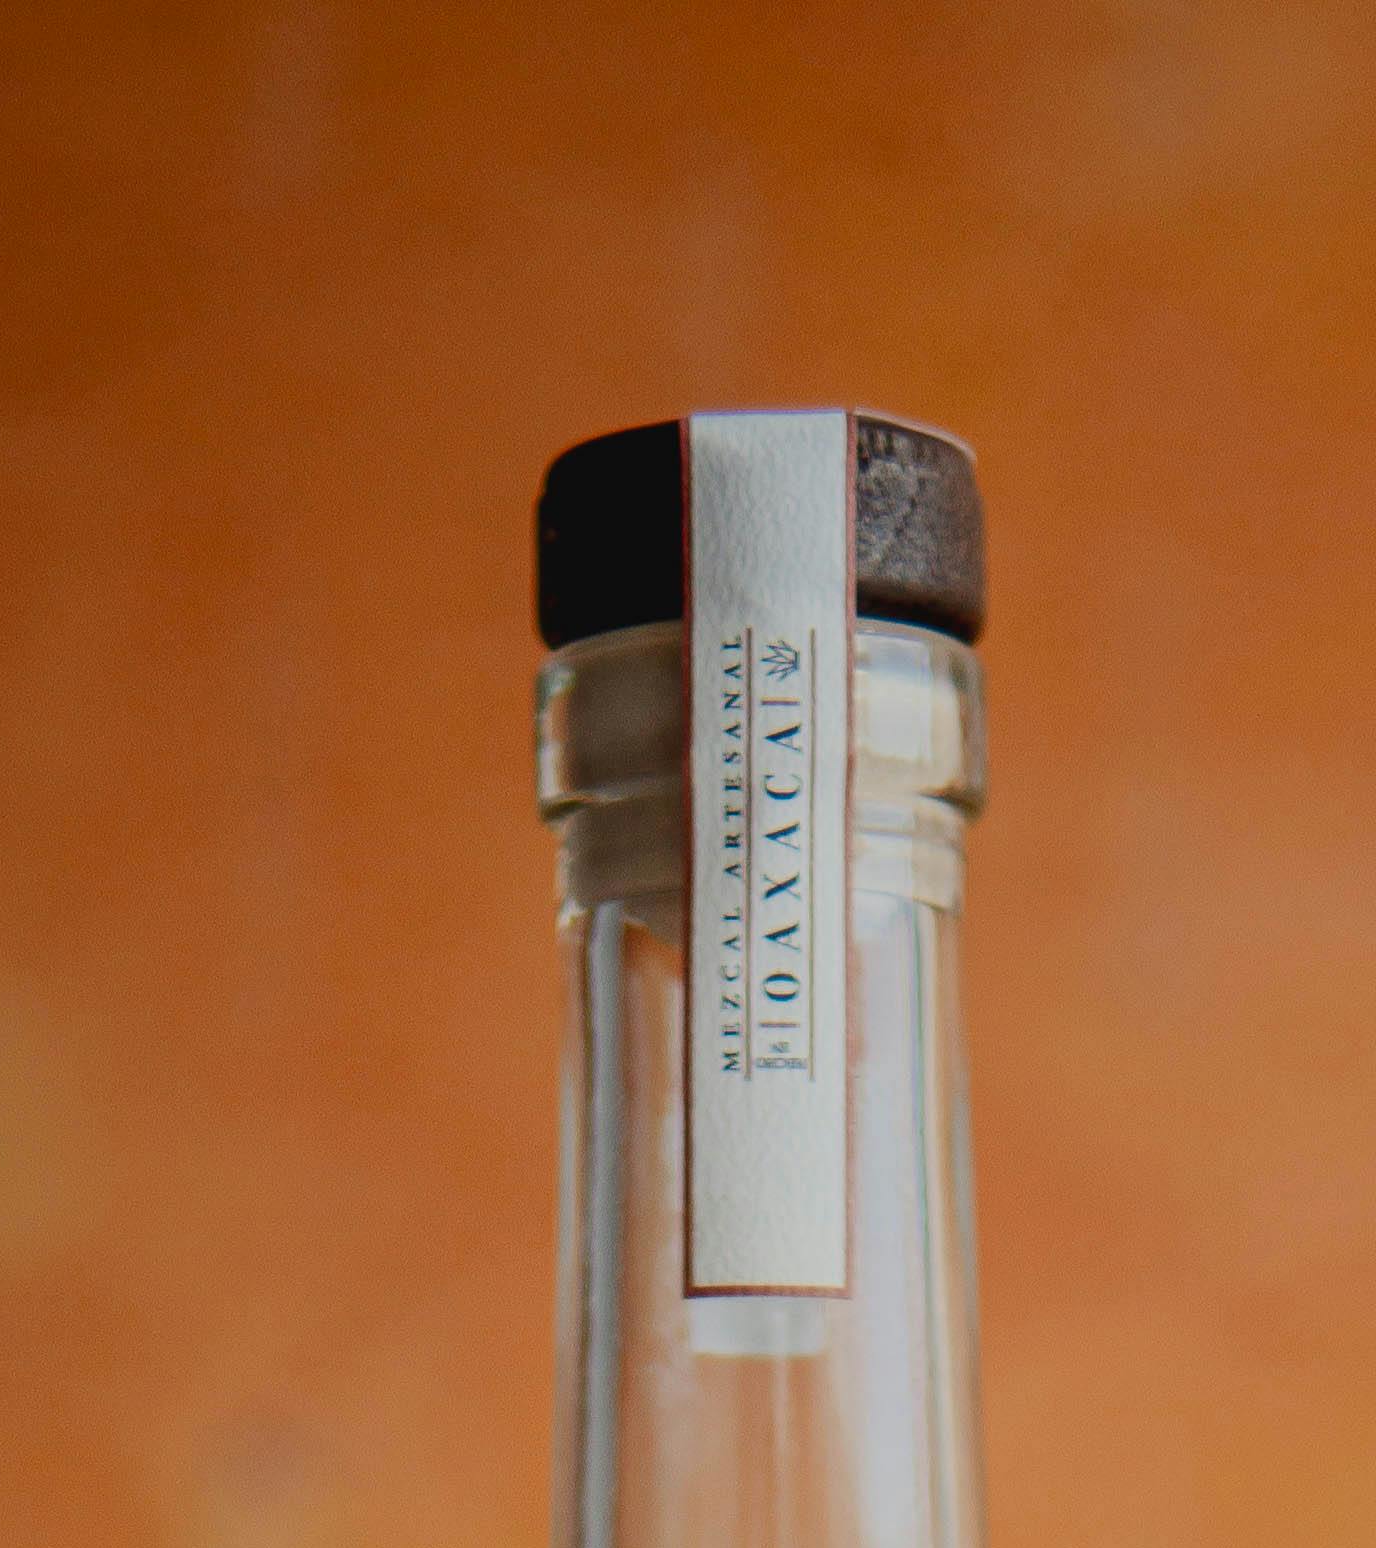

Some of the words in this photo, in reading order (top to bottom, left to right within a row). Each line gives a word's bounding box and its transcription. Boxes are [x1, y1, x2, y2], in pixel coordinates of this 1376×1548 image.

[721, 634, 742, 877] ARTESANAL
[762, 723, 802, 1002] OAXACA
[721, 905, 740, 1072] MEZCAL
